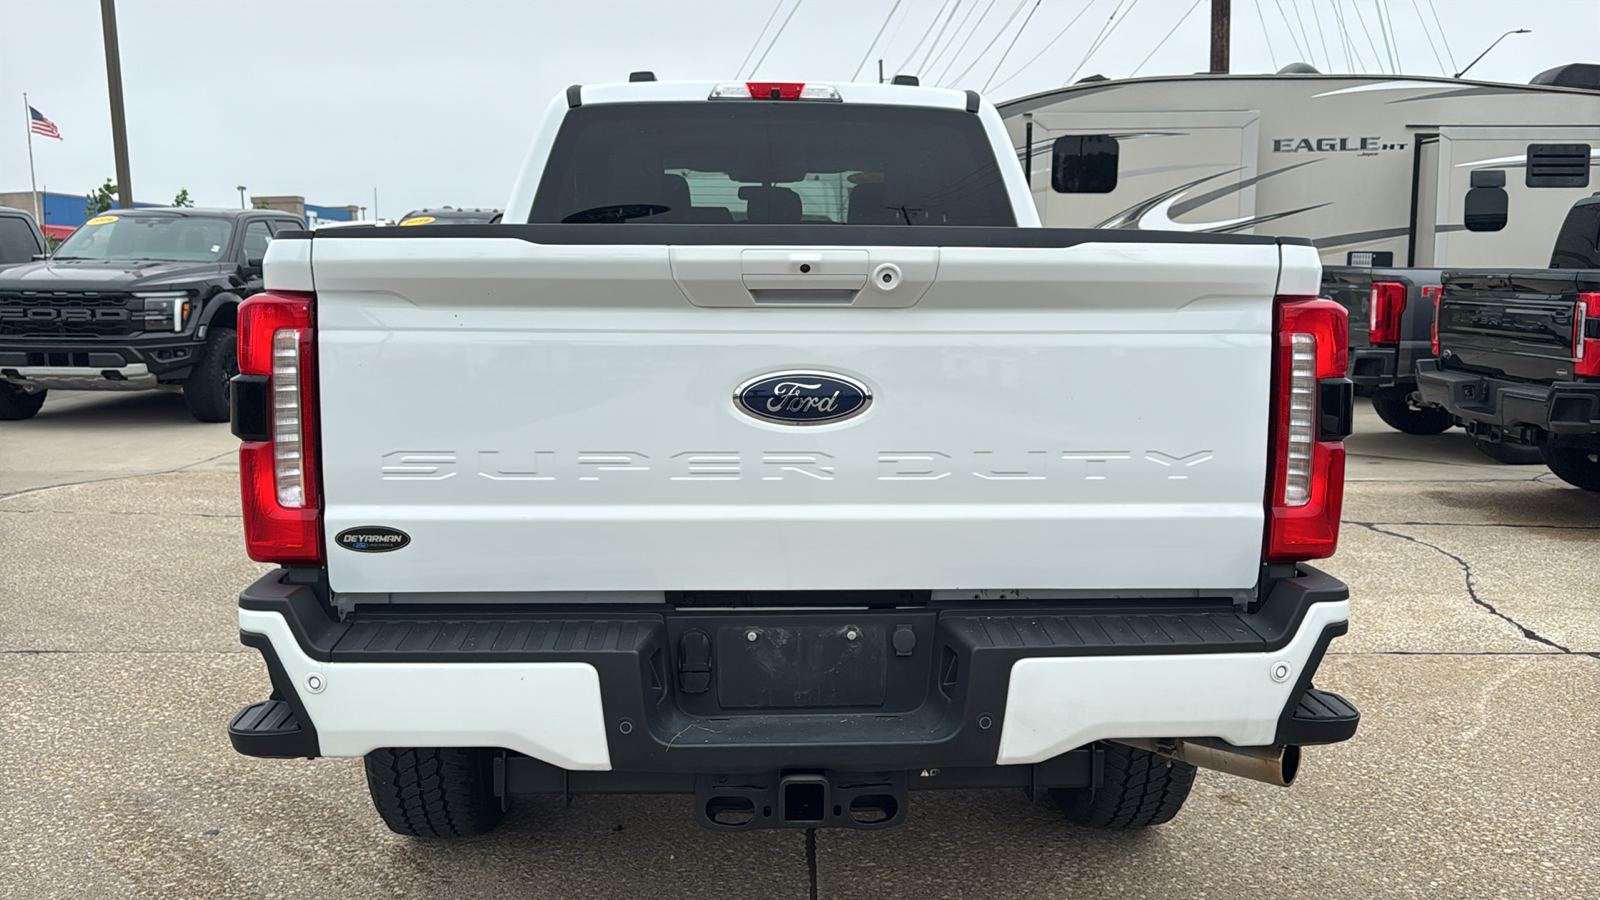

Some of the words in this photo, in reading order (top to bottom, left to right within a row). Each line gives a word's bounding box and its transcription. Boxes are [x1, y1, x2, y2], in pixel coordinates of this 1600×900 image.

[1272, 136, 1381, 153] EAGLE
[0, 308, 131, 321] FORD
[766, 382, 840, 412] Ford
[381, 449, 836, 481] SUPER
[877, 449, 1215, 481] DUTY
[344, 534, 402, 543] DEYARMAN
